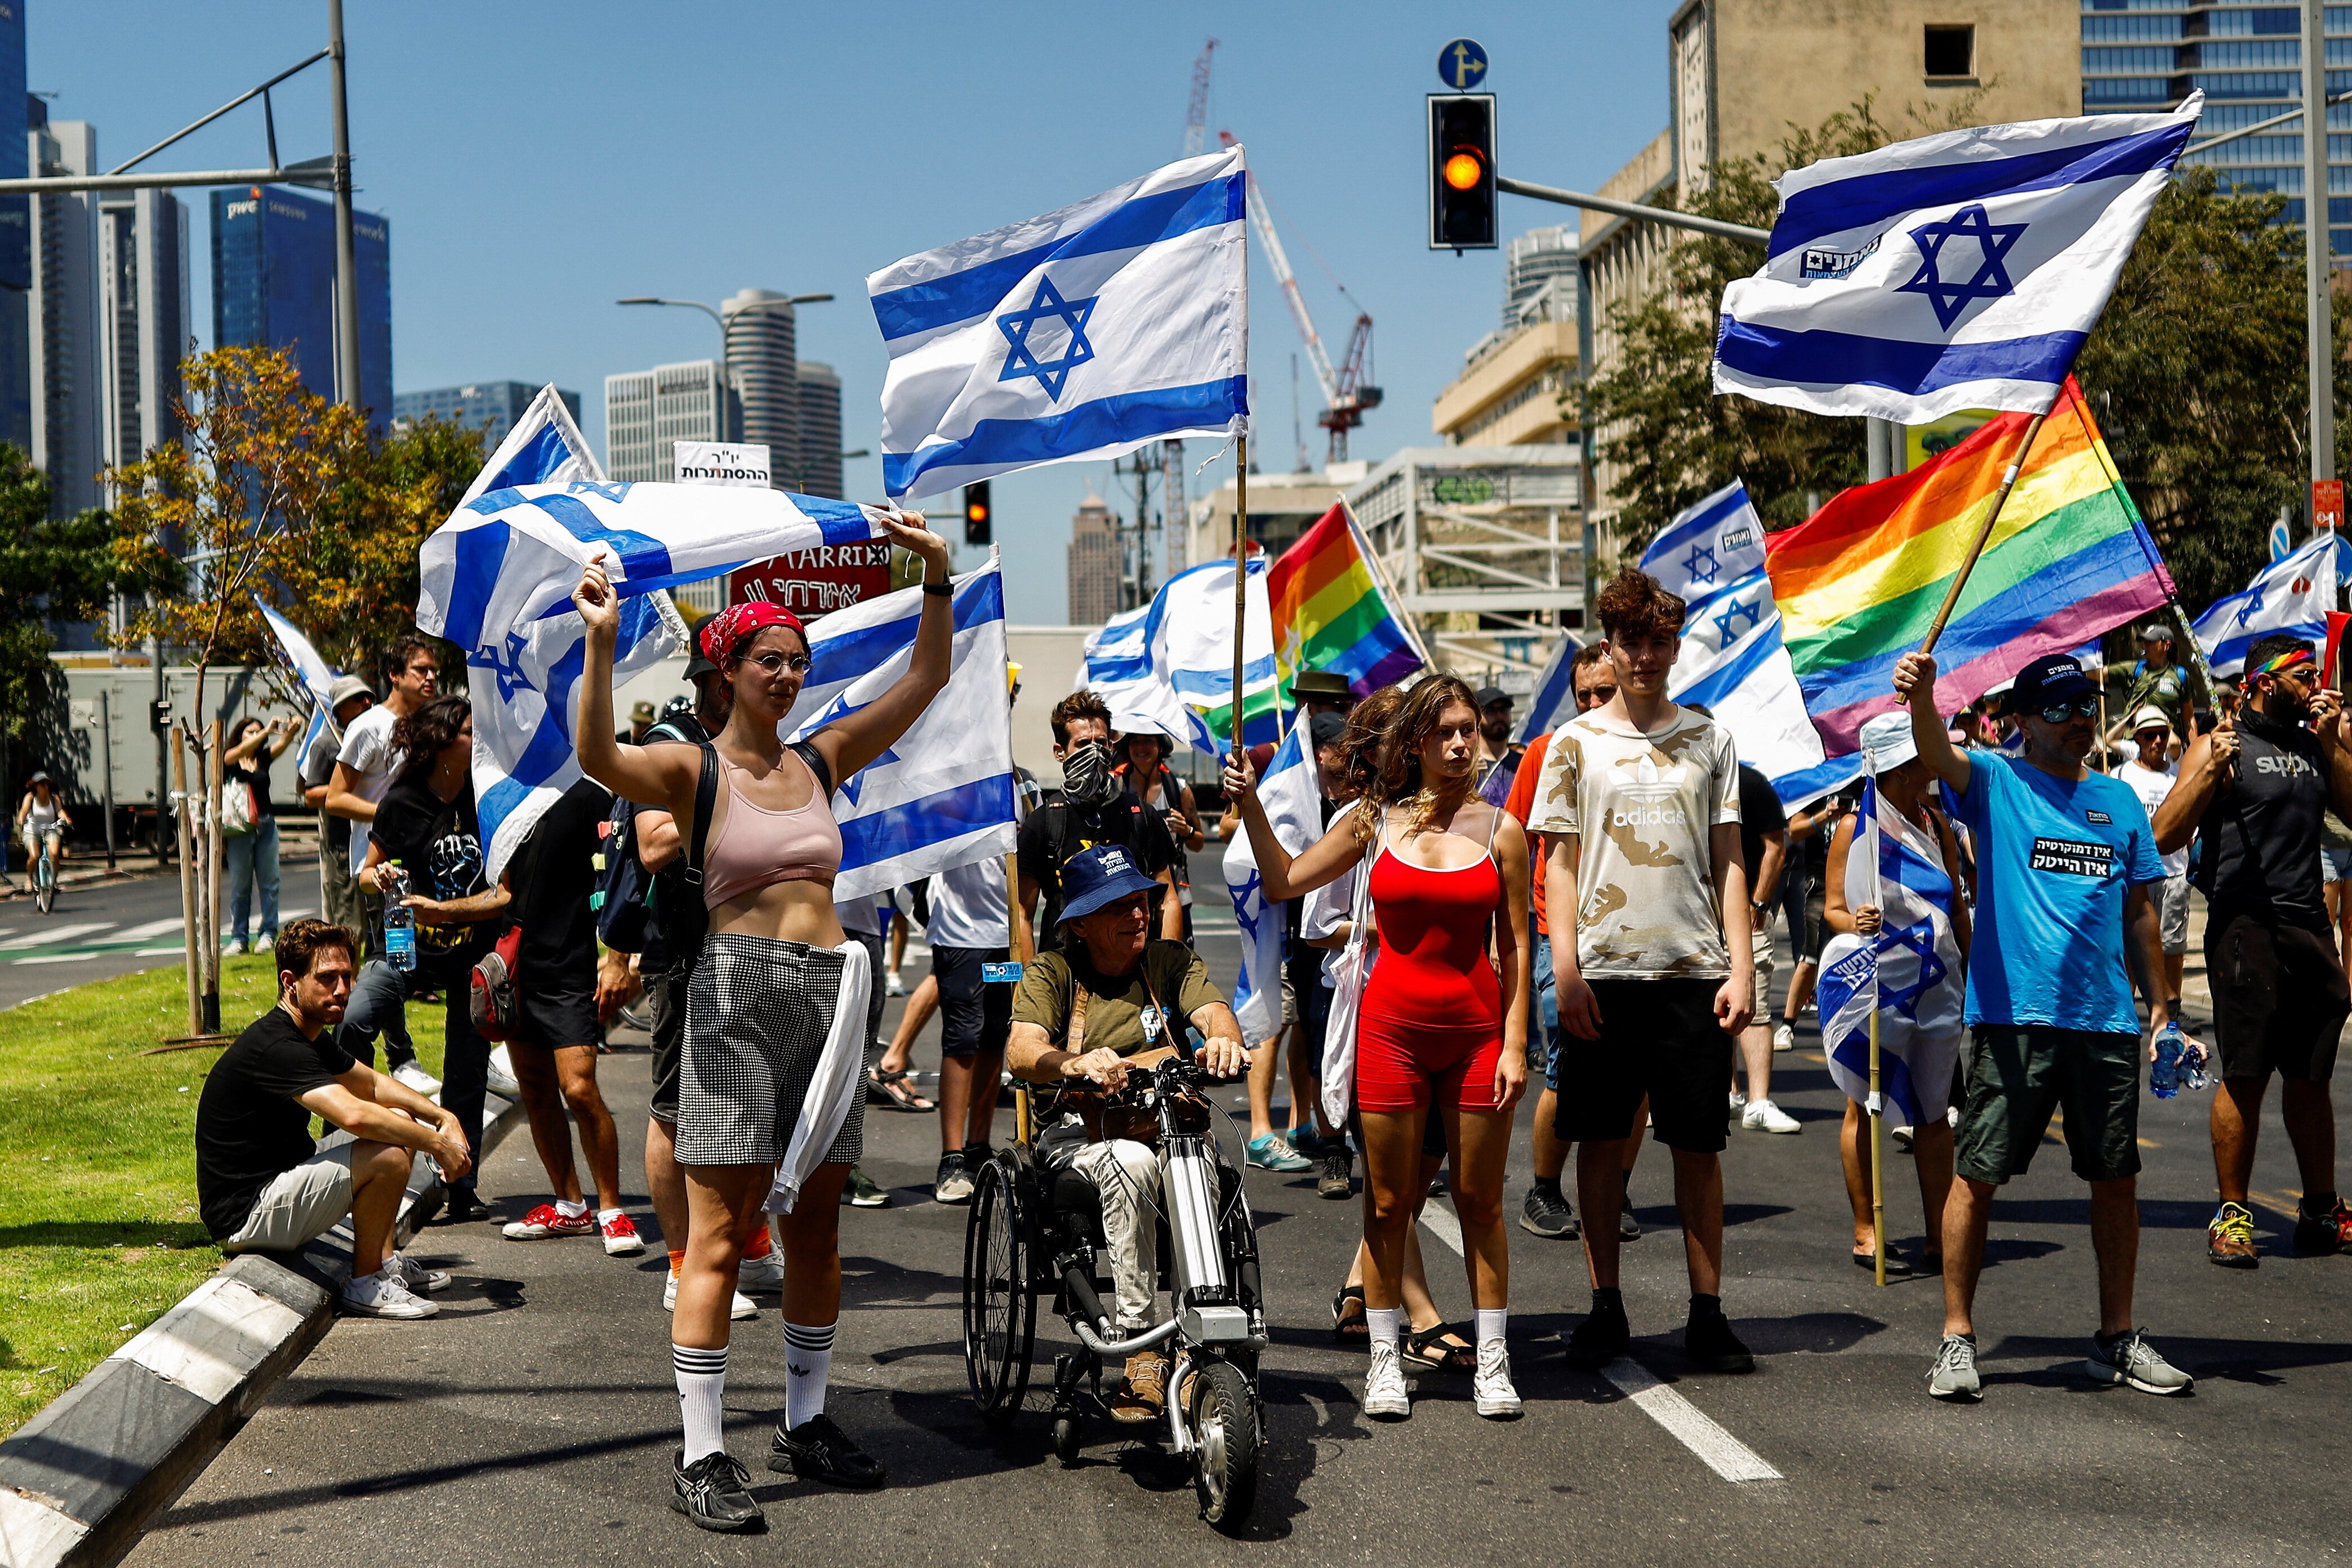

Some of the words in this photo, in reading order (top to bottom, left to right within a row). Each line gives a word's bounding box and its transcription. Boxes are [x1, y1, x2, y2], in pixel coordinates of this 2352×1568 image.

[227, 200, 257, 219] pwc
[1806, 237, 1879, 270] נאמנים
[711, 451, 739, 464] יו"ר
[2047, 664, 2075, 675] נאמנים
[1613, 805, 1687, 827] adidas
[2037, 840, 2092, 854] דמוקרטיה
[2093, 846, 2111, 857] אין
[2033, 854, 2081, 872] הייטק
[2083, 861, 2108, 876] אין
